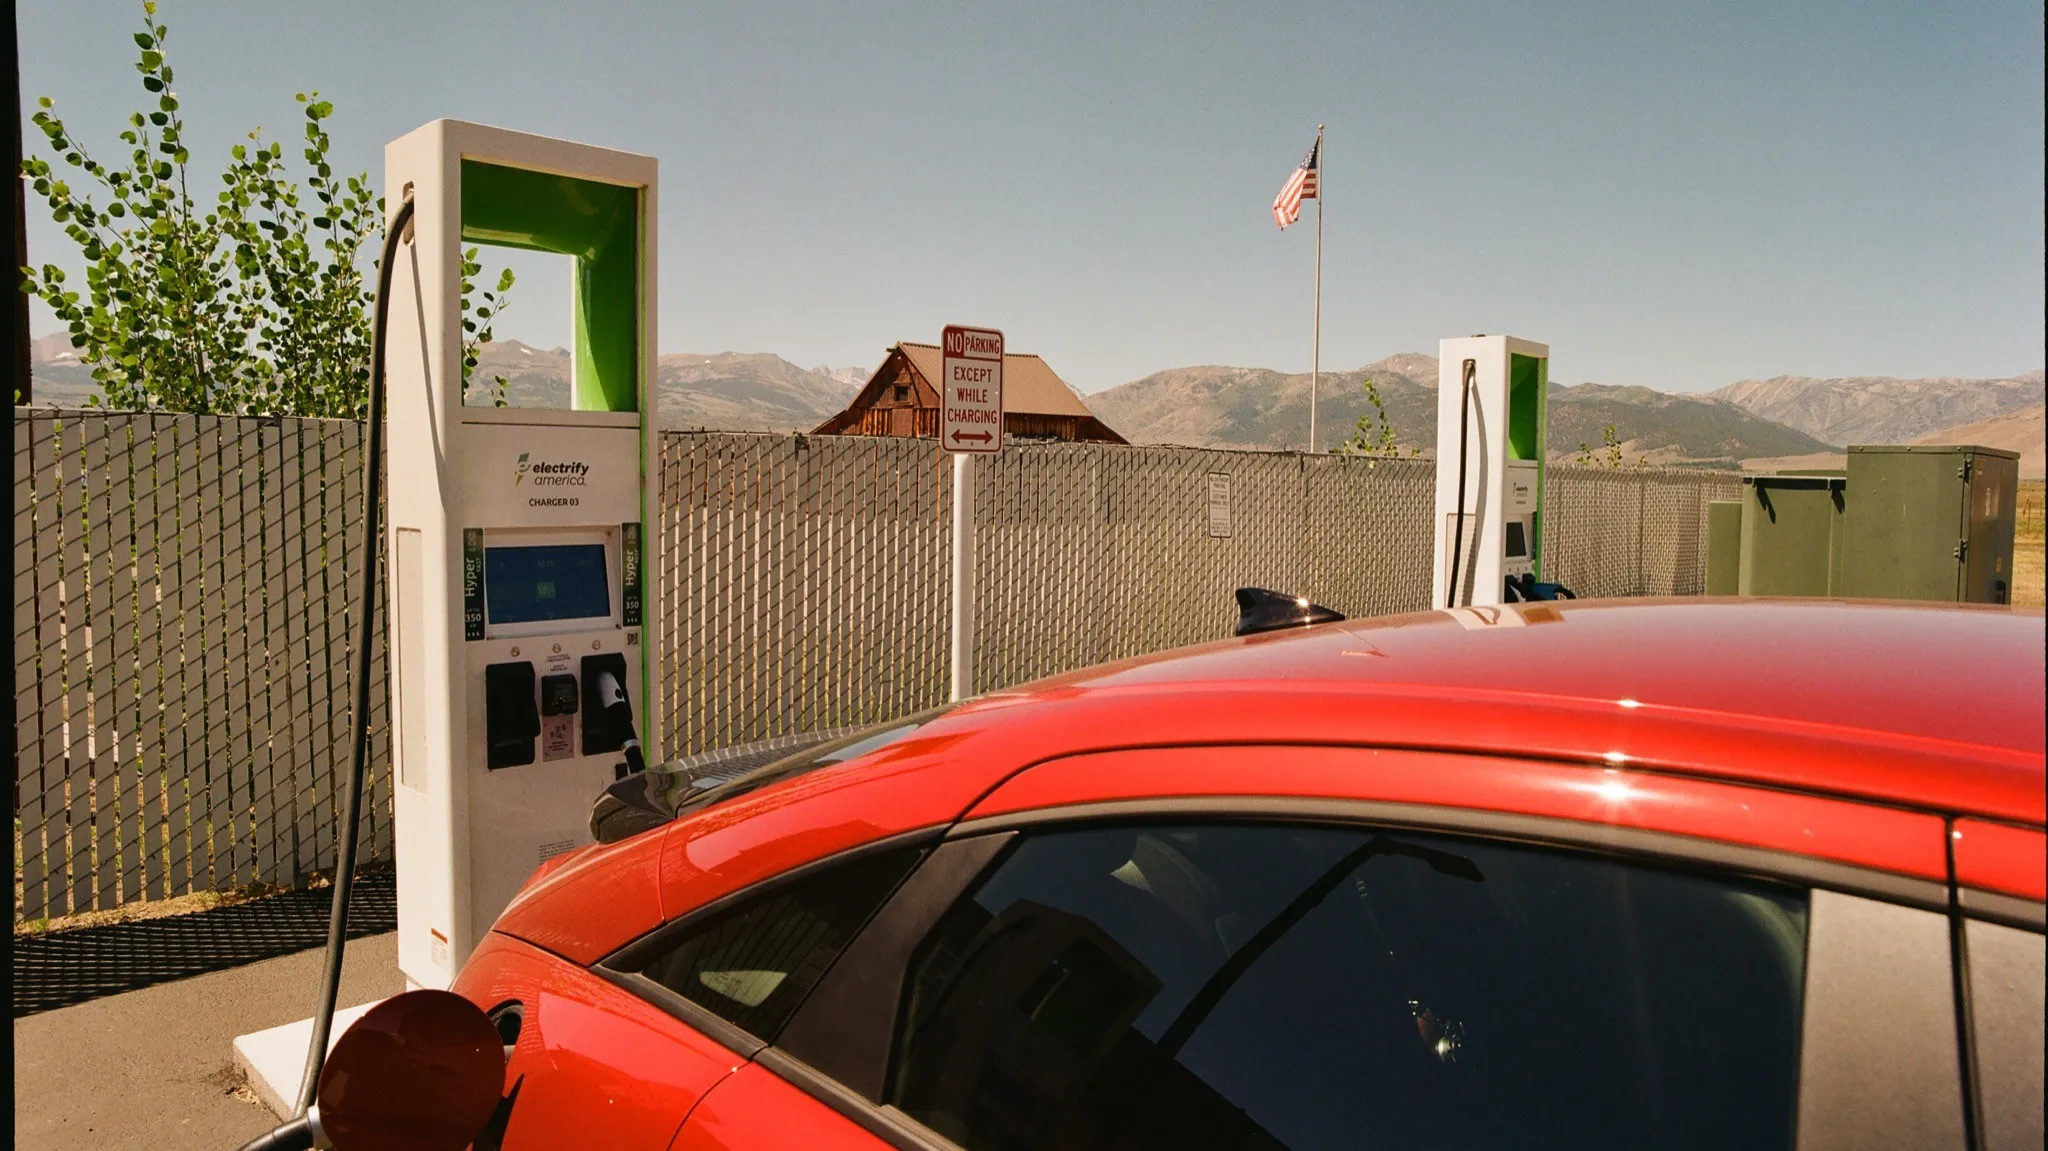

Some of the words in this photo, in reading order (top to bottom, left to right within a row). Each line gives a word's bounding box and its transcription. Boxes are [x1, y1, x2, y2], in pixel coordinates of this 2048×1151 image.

[947, 332, 962, 353] NO
[965, 336, 1000, 355] PARKING
[953, 366, 993, 383] EXCEPT
[957, 387, 988, 404] WHILE
[947, 408, 997, 424] CHARGING
[532, 461, 589, 476] electrify
[528, 498, 568, 507] CHARGER
[569, 498, 580, 507] 03
[625, 549, 637, 586] Hyper
[464, 557, 478, 597] Hyper
[625, 601, 639, 610] 350
[465, 613, 482, 622] 350
